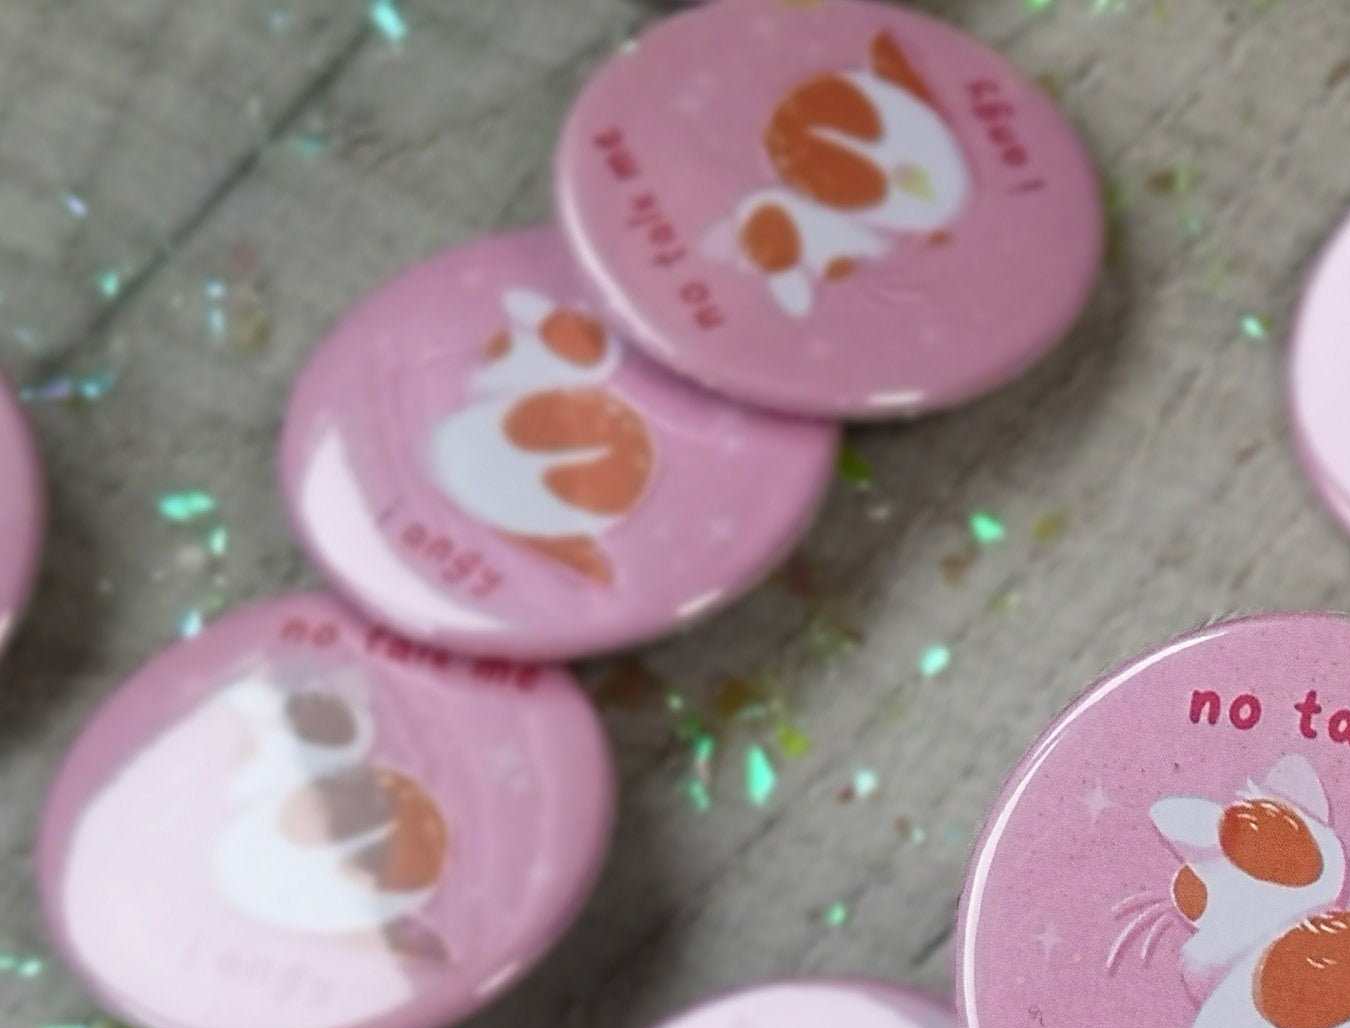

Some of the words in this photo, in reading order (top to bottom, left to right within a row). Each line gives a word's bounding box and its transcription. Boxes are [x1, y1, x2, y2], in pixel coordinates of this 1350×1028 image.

[965, 79, 1030, 168] angy
[593, 124, 638, 182] me
[627, 190, 687, 267] talk
[680, 282, 723, 330] no
[403, 522, 503, 597] angy
[280, 618, 339, 647] no
[1188, 689, 1261, 730] no
